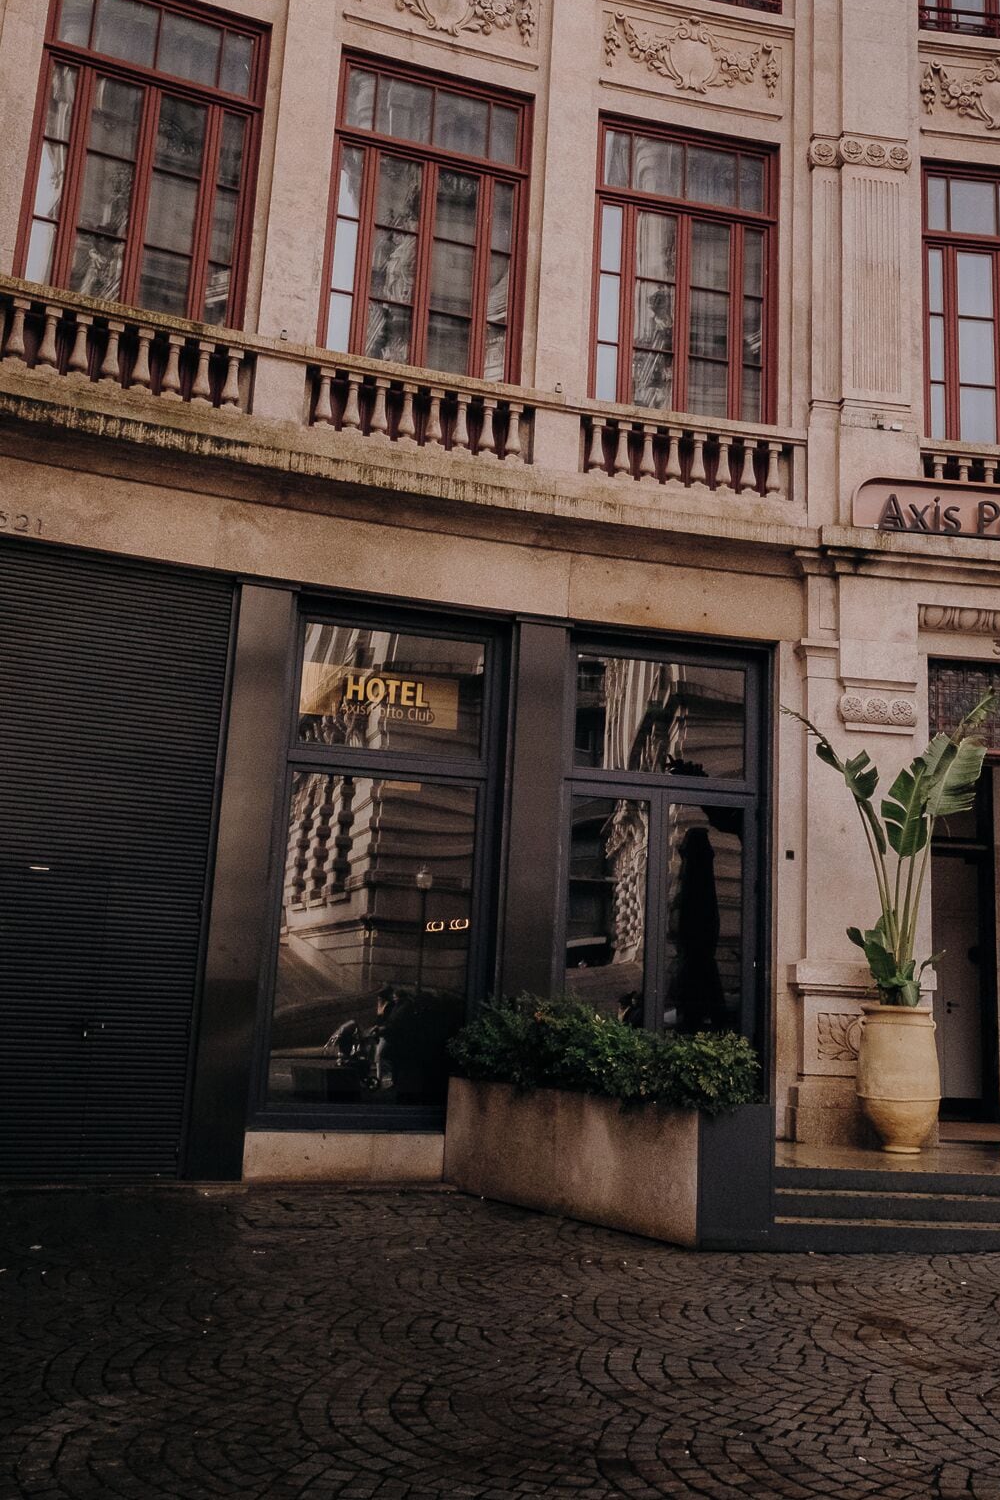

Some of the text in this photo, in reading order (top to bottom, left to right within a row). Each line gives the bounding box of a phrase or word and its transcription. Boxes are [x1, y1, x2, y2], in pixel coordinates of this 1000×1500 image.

[879, 493, 961, 532] Axis
[346, 675, 429, 708] HOTEL
[407, 708, 435, 723] Club
